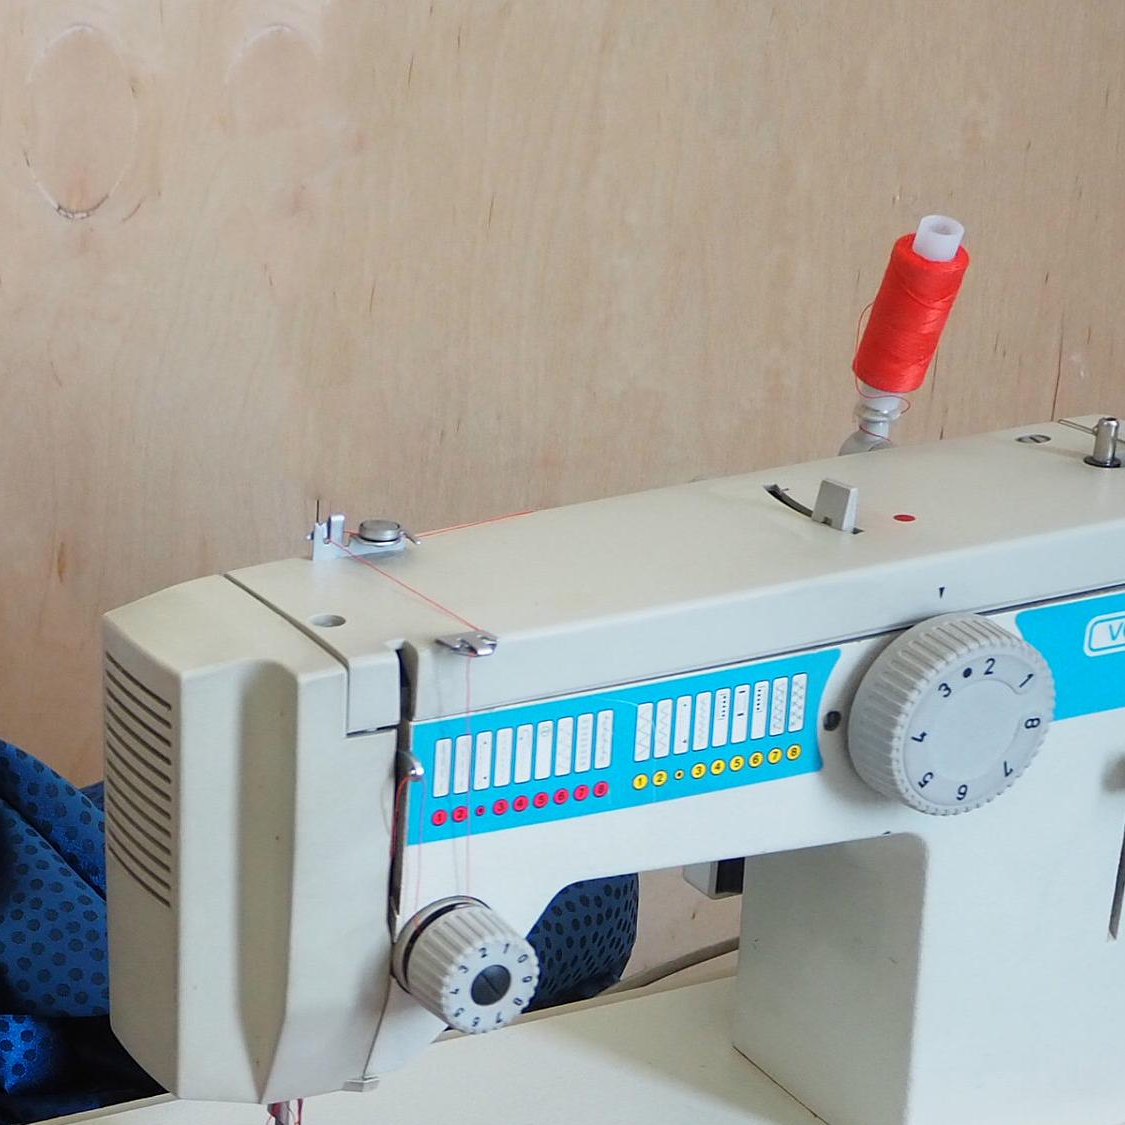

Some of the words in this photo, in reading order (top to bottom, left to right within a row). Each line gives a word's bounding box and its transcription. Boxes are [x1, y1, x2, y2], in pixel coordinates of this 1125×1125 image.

[1108, 621, 1125, 641] V
[983, 658, 995, 675] 2
[1019, 673, 1034, 688] 1
[938, 683, 952, 697] 3
[1024, 717, 1041, 729] 8
[911, 731, 928, 742] 4
[918, 771, 934, 788] 5
[956, 784, 968, 800] 6
